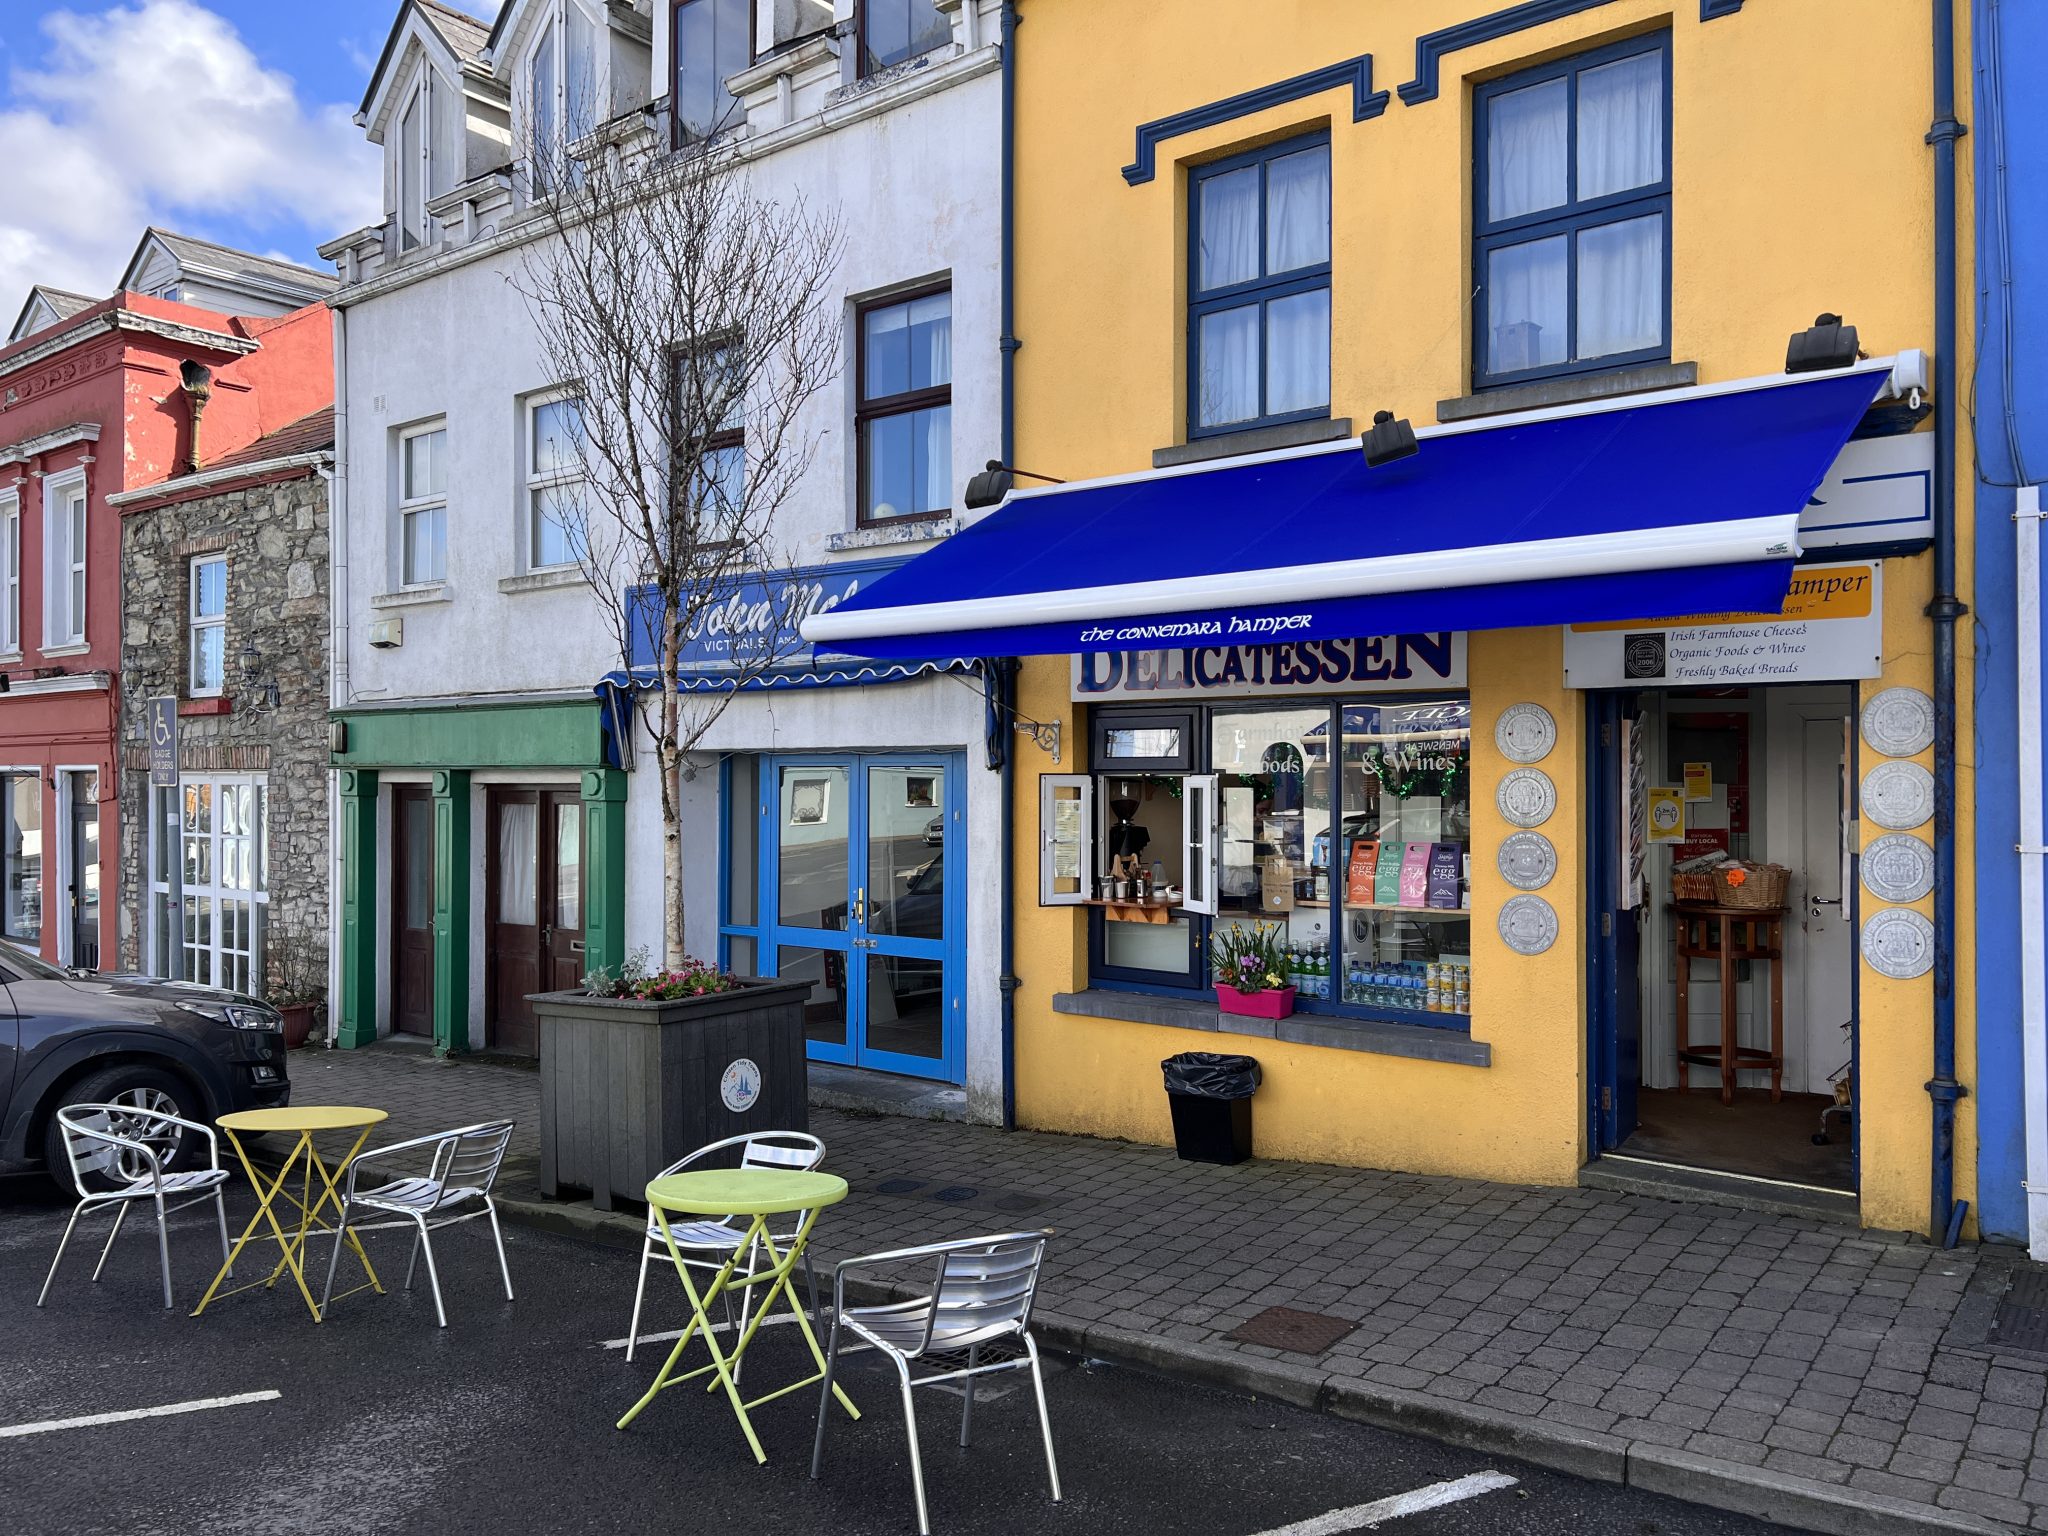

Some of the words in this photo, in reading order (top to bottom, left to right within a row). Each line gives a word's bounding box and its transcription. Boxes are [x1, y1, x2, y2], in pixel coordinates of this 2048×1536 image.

[1785, 574, 1869, 601] amper
[686, 590, 774, 641] John
[777, 636, 798, 645] AND
[1670, 631, 1696, 641] Irish
[1698, 627, 1760, 642] Farmhouse
[1669, 648, 1712, 661] Organic
[1714, 644, 1750, 658] Foods
[1753, 645, 1765, 655] &
[1768, 642, 1807, 654] Wines
[1077, 631, 1452, 693] DELICATESSEN
[1675, 665, 1716, 679] Freshly
[1719, 663, 1755, 676] Baked
[1758, 661, 1800, 674] Breads
[154, 749, 171, 758] BADGE
[153, 761, 174, 770] HOLDERS
[1361, 752, 1381, 775] &
[1383, 751, 1457, 773] Wines
[157, 772, 169, 781] ONLY
[1352, 865, 1373, 876] egg
[1432, 867, 1456, 880] egg
